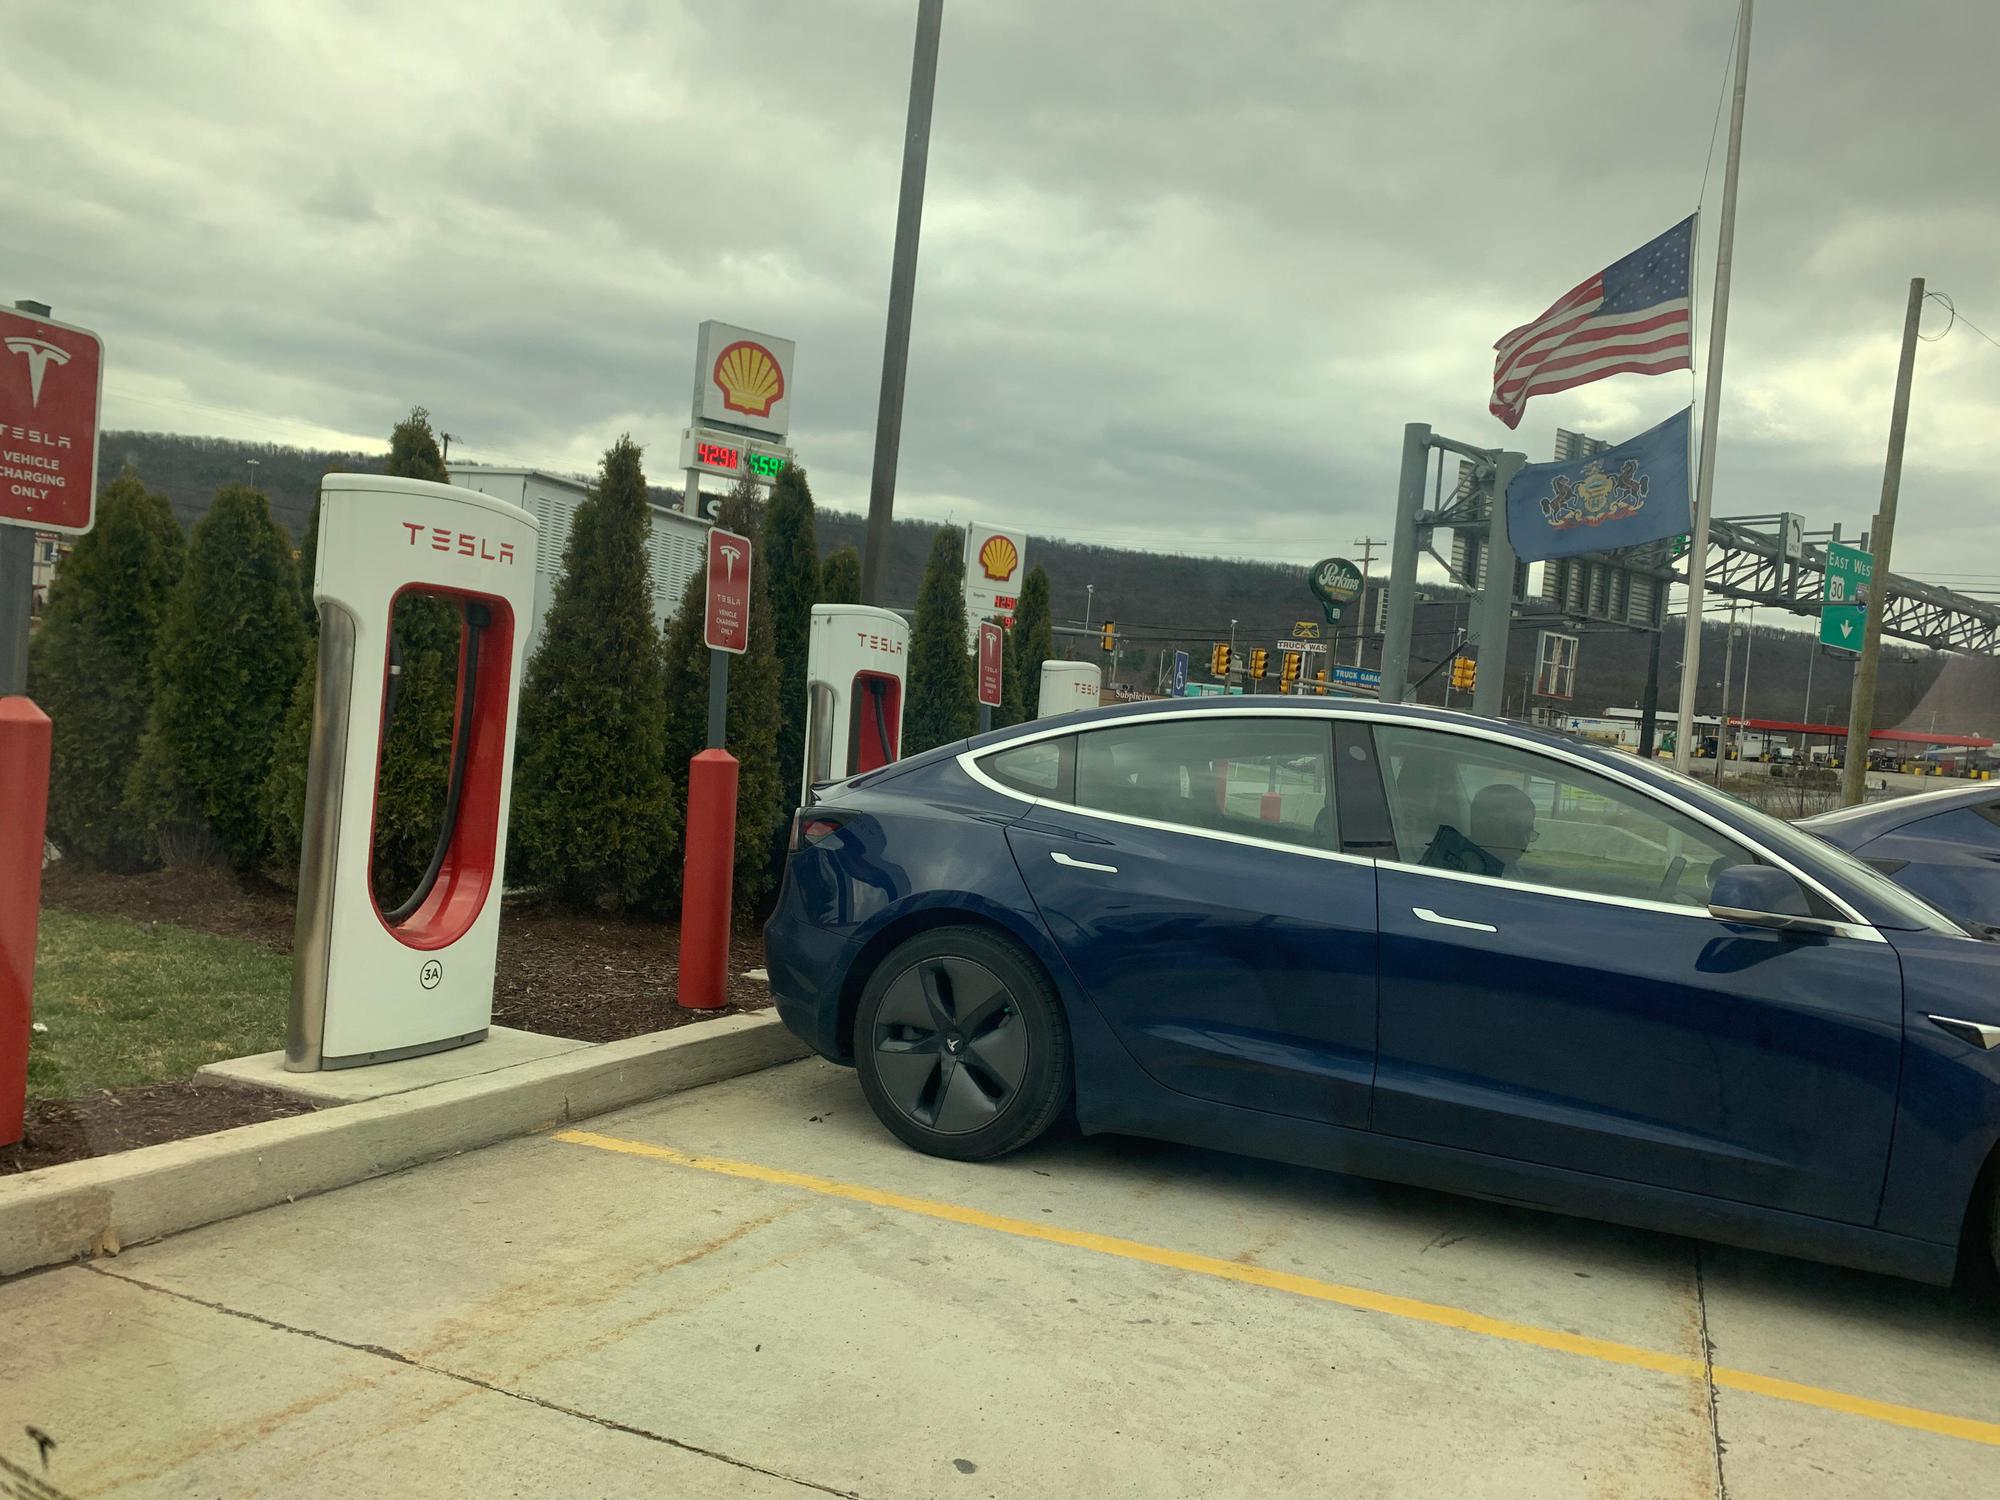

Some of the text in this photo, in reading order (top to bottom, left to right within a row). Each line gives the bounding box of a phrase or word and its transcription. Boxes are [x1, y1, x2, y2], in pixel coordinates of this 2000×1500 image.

[3, 450, 60, 470] VEHICLE
[11, 484, 48, 500] ONLY
[402, 521, 514, 565] TESLA
[1829, 552, 1873, 577] EAST WES
[1319, 562, 1360, 591] Perkins
[1831, 581, 1843, 599] 30
[716, 593, 741, 606] TESLA
[719, 608, 737, 619] VEHICLE
[857, 633, 902, 655] TESLA
[1279, 641, 1306, 650] TRUCK
[1335, 669, 1358, 679] TRUCK
[1115, 689, 1152, 702] Subplicity
[424, 967, 439, 980] 3A
